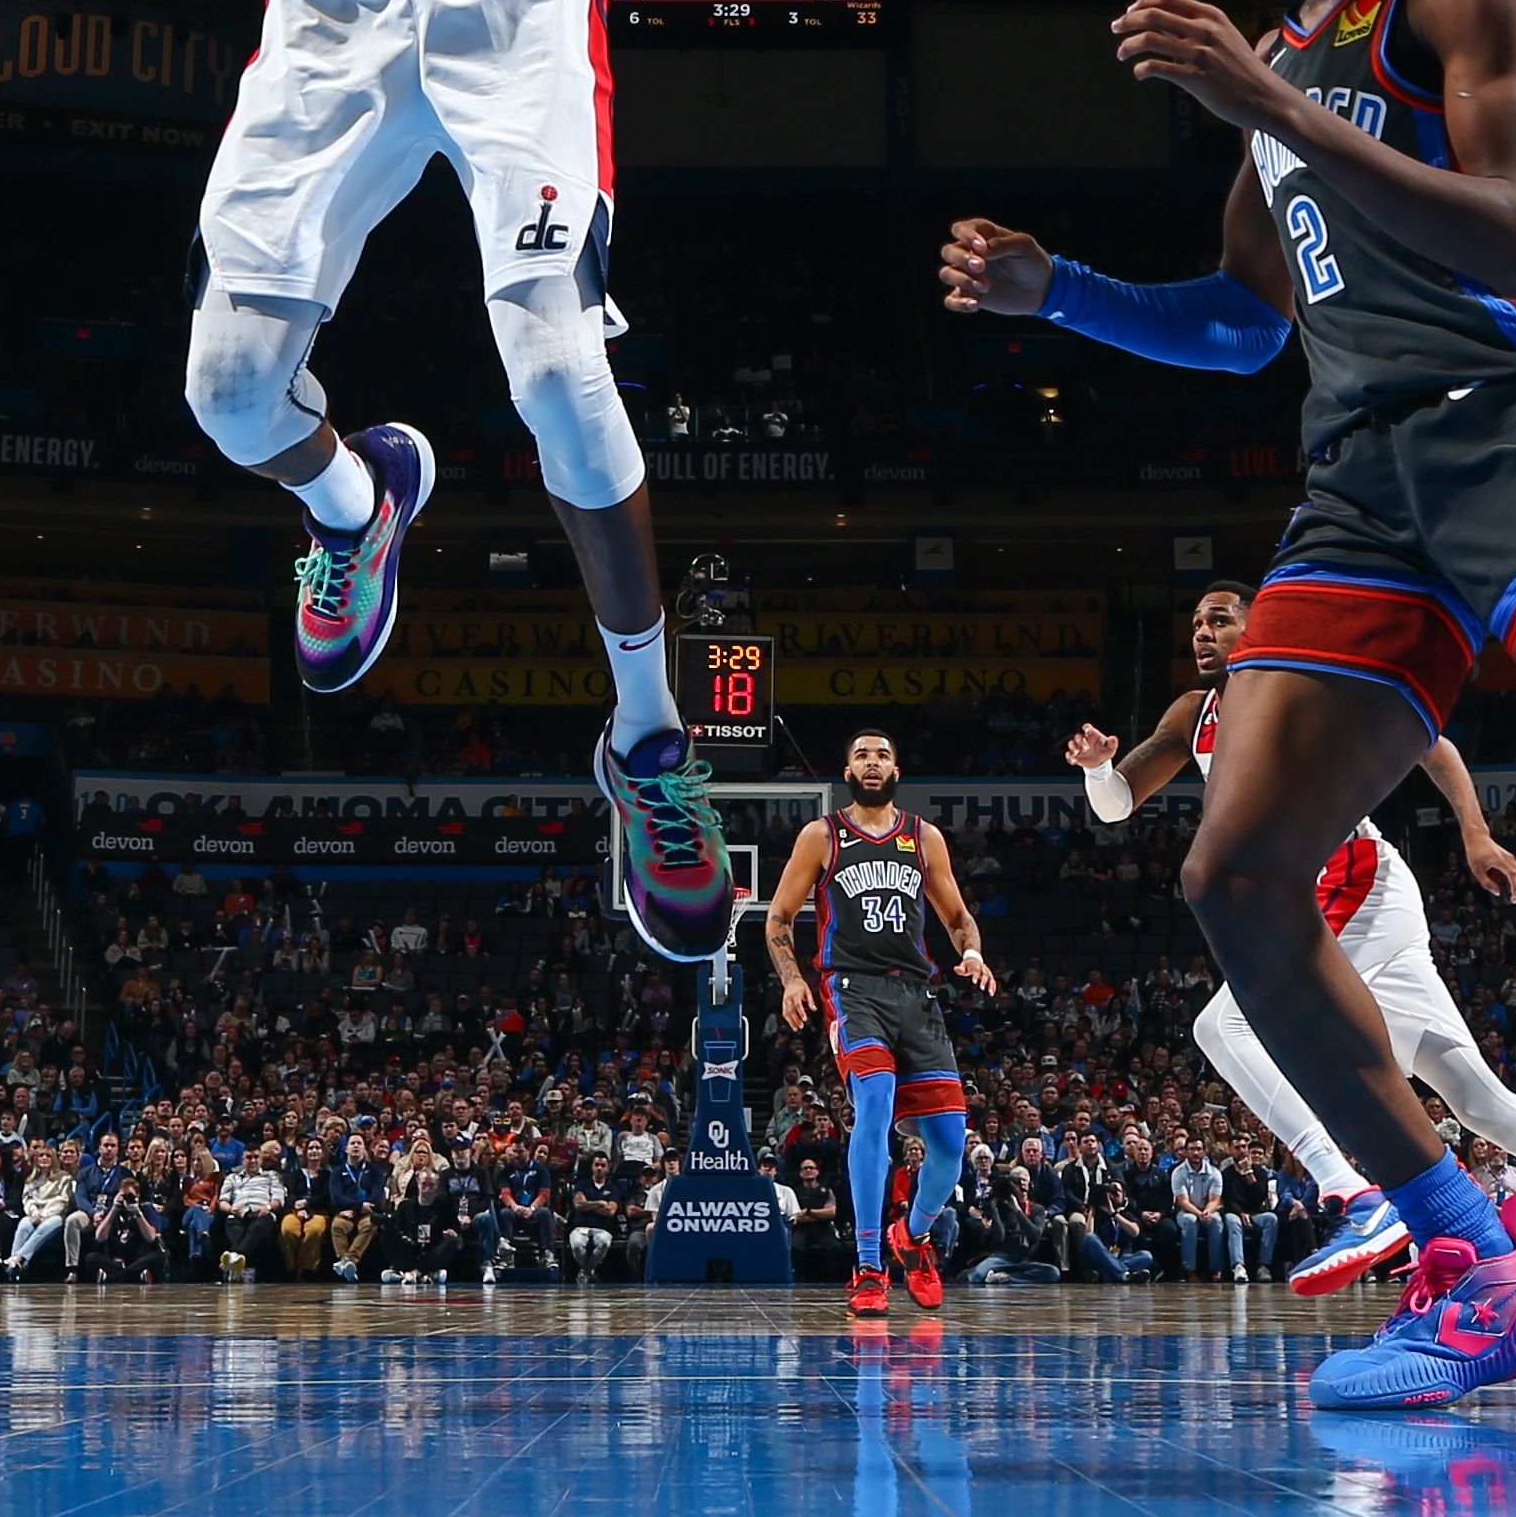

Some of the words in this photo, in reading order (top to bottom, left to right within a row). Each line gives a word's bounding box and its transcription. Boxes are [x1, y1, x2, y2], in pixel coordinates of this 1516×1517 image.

[629, 11, 640, 25] 6
[713, 3, 751, 16] 3:29
[788, 11, 799, 25] 3
[804, 18, 821, 26] TOL
[847, 1, 881, 10] Wizards
[856, 11, 877, 25] 33
[723, 18, 740, 26] FLS
[132, 19, 234, 106] CITY
[70, 119, 133, 143] EXIT
[142, 126, 206, 148] NOW
[1286, 194, 1347, 306] 2
[1, 433, 100, 470] ENERGY.
[134, 455, 197, 475] devon
[646, 451, 699, 481] FULL
[704, 451, 732, 481] OF
[739, 451, 835, 481] ENERGY.
[864, 462, 926, 481] devon
[1139, 463, 1201, 481] devon
[1231, 446, 1289, 477] LIVE.
[779, 623, 1084, 654] RIVERWIND
[707, 643, 761, 671] 3:29
[415, 668, 614, 699] CASINO
[713, 672, 755, 718] 18
[829, 668, 1026, 697] CASINO
[703, 724, 767, 739] TISSOT
[92, 831, 154, 851] devon
[193, 834, 255, 854] devon
[293, 836, 355, 855] devon
[394, 836, 456, 855] devon
[494, 835, 557, 855] devon
[834, 860, 922, 900] THUNDER
[860, 895, 907, 933] 34
[707, 1120, 729, 1149] OU
[690, 1149, 749, 1171] Health
[666, 1201, 771, 1217] ALWAYS
[666, 1218, 771, 1233] ONWARD
